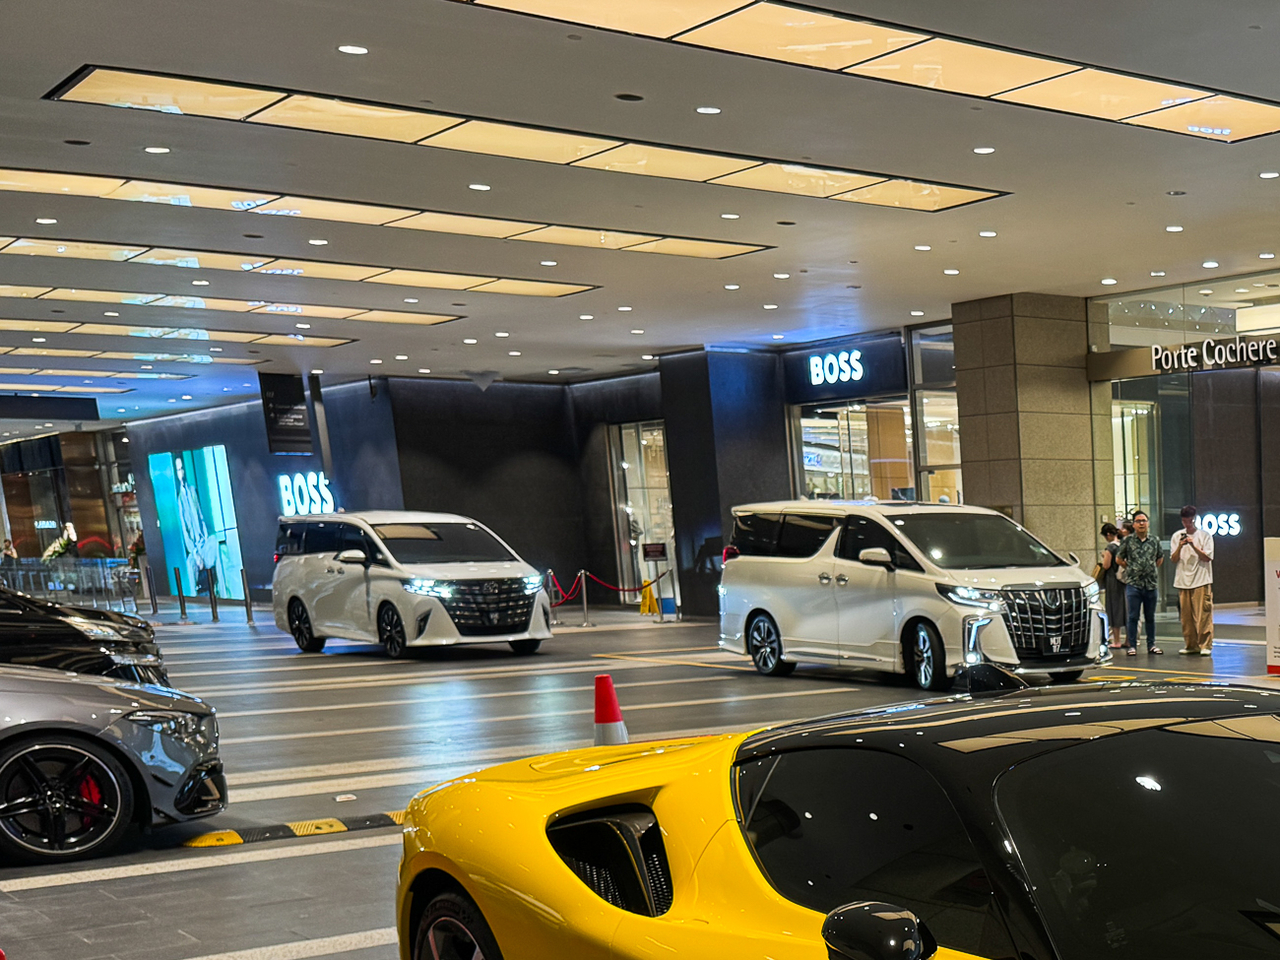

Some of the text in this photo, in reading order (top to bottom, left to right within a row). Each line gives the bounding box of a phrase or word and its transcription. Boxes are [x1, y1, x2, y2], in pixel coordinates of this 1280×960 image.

[809, 349, 864, 386] BOSS
[1151, 344, 1197, 370] Porte
[1202, 335, 1277, 365] Cochere
[279, 471, 334, 517] BOSS
